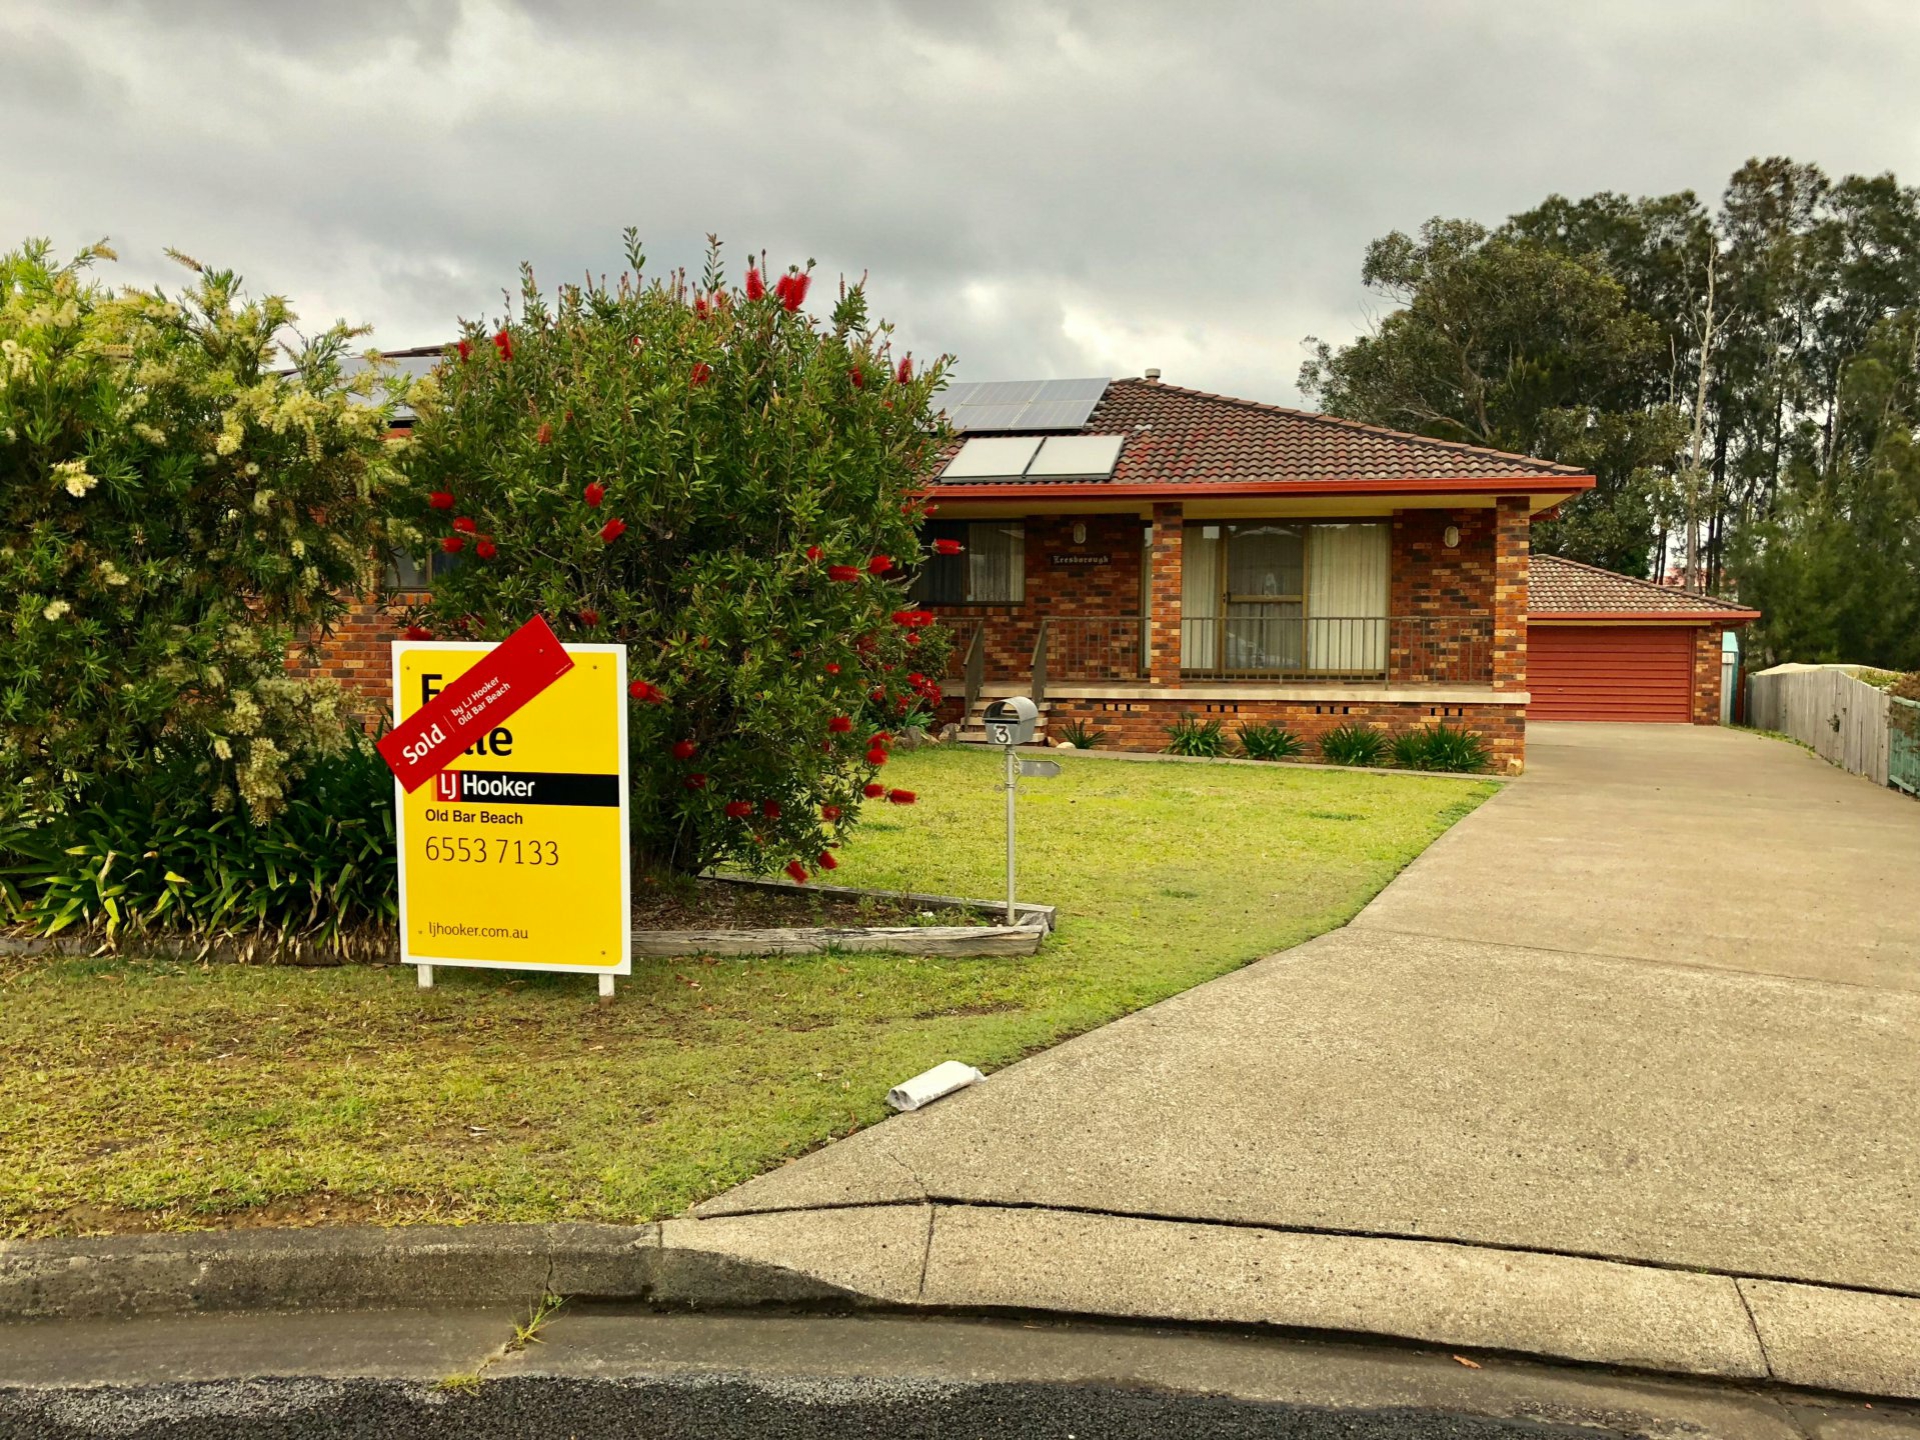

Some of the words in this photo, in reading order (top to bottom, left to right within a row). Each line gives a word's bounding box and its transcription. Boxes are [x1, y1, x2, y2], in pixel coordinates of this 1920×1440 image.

[450, 705, 465, 717] by
[462, 696, 473, 708] LJ
[471, 675, 500, 701] Hooker
[457, 711, 474, 726] Old
[470, 701, 487, 715] Bar
[485, 681, 511, 704] Beach
[402, 723, 447, 765] Sold
[995, 725, 1009, 743] 3
[440, 773, 457, 800] LJ
[462, 774, 536, 798] Hooker
[425, 808, 449, 823] Old
[453, 810, 476, 824] Bar
[480, 811, 524, 825] Beach
[425, 836, 488, 863] 6553
[496, 839, 560, 866] 7133
[428, 921, 529, 940] ljhooker.com.au
